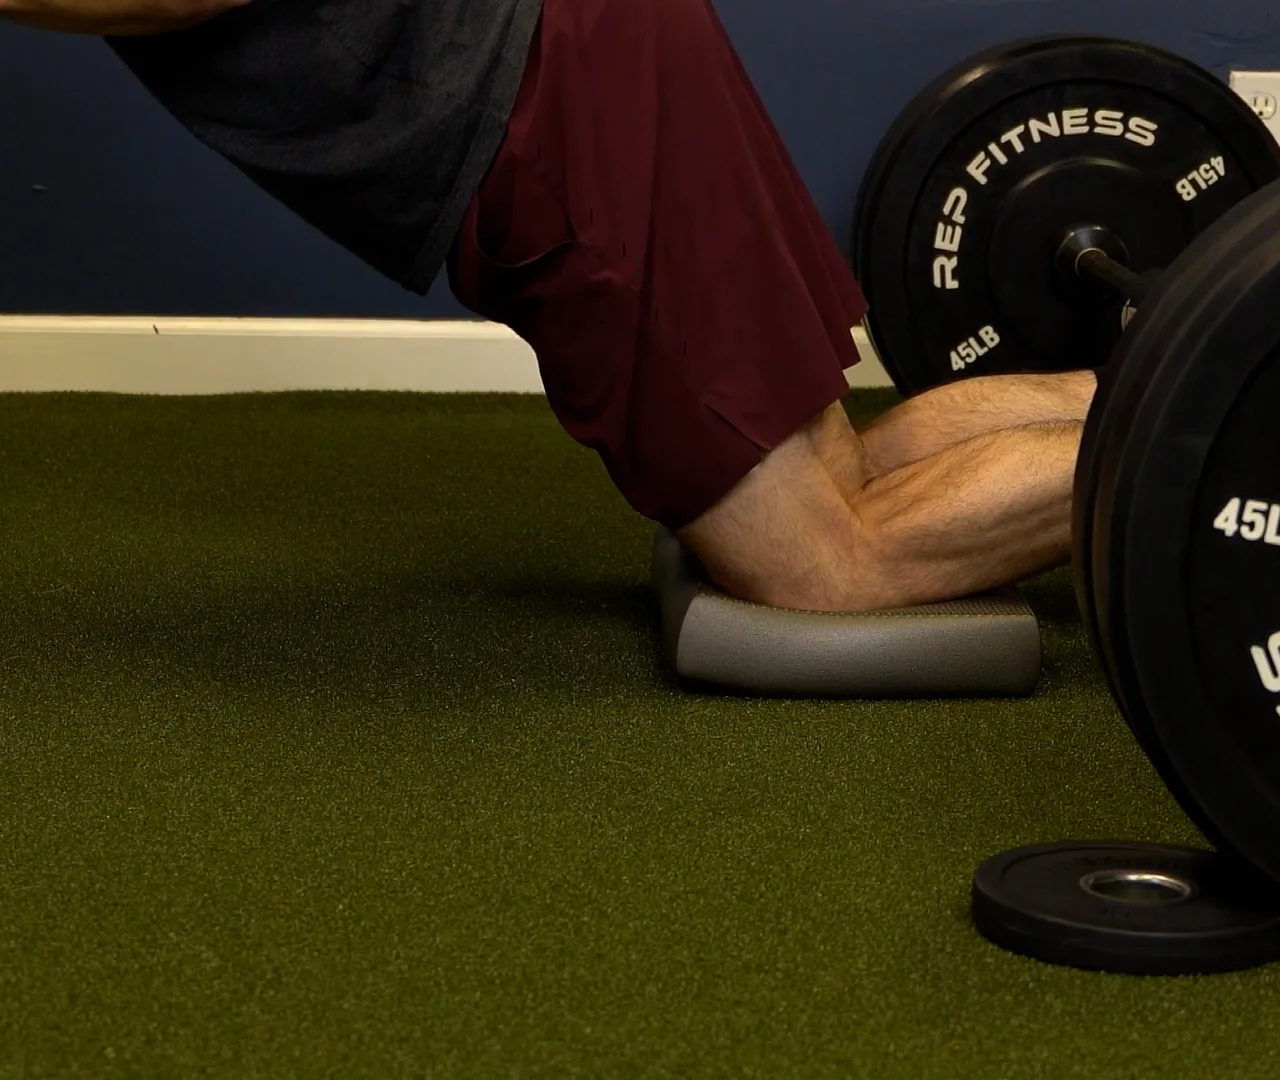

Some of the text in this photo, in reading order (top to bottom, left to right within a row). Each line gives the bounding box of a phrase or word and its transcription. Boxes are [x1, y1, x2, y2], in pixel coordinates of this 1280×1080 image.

[932, 106, 1159, 291] REP FITNESS
[1174, 155, 1226, 202] 45LB
[949, 324, 1001, 372] 45LB
